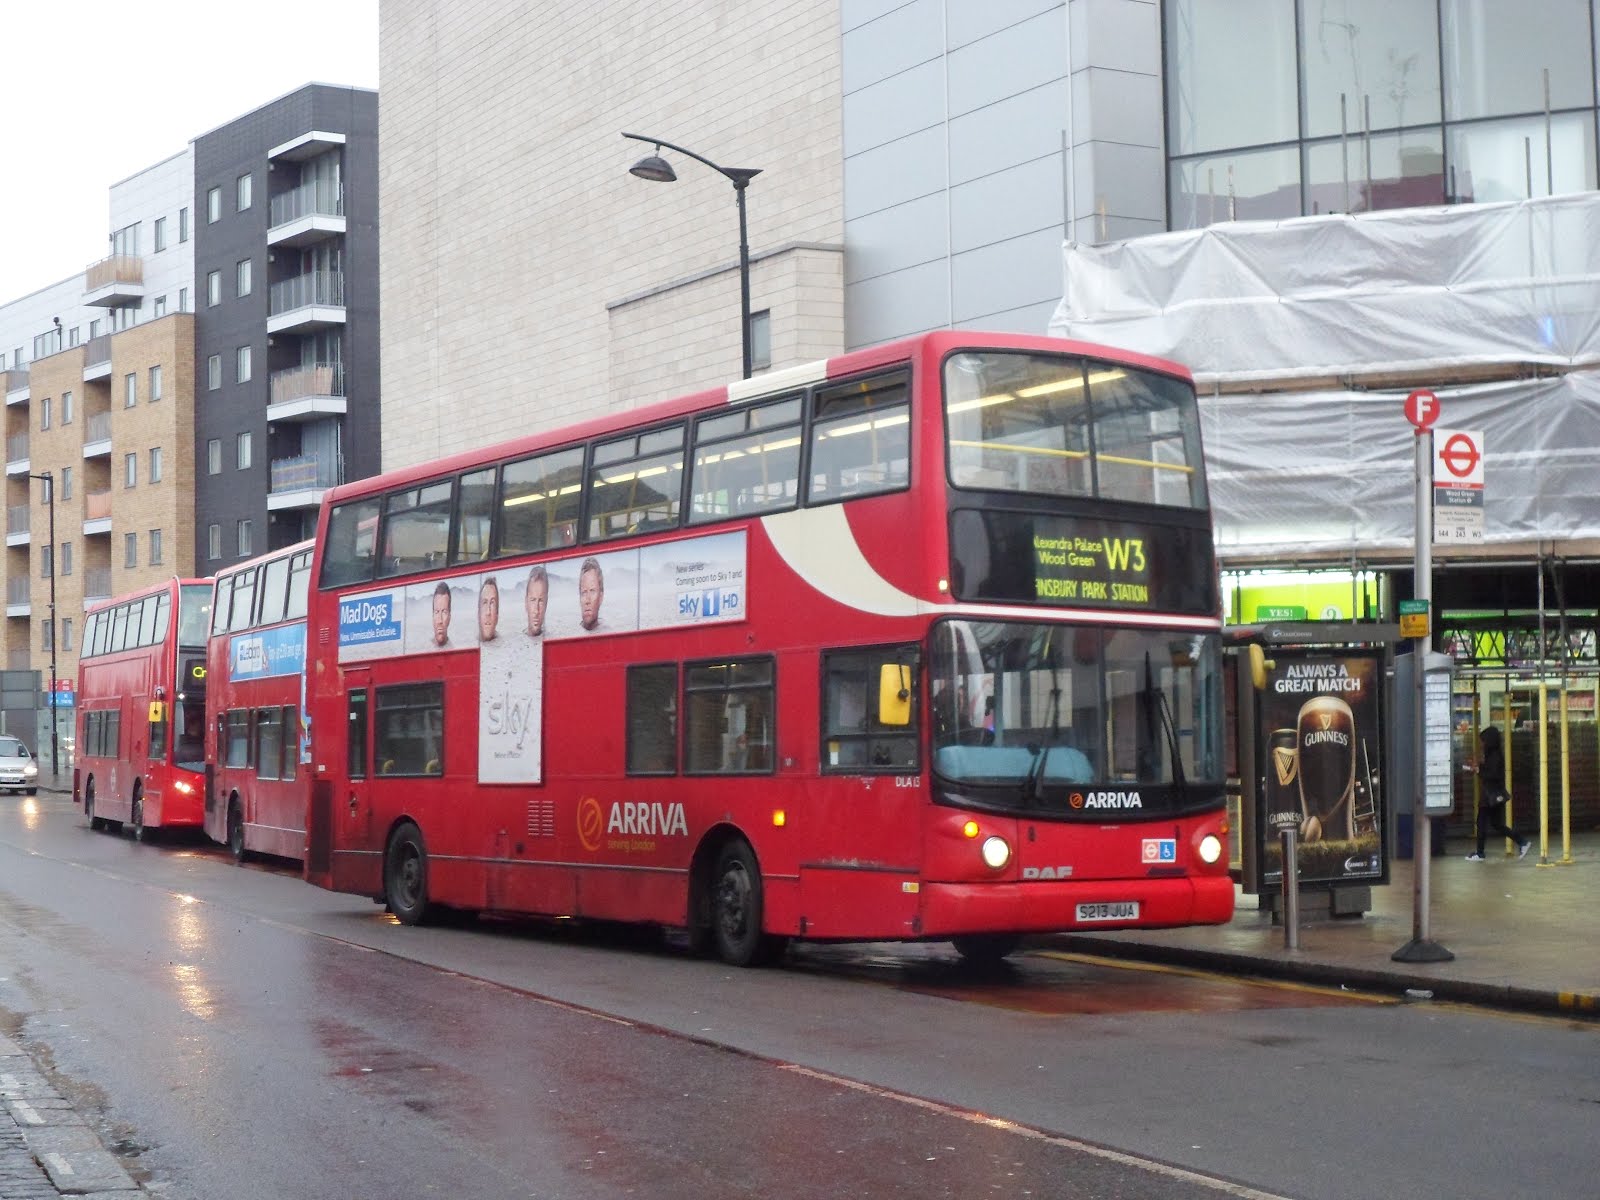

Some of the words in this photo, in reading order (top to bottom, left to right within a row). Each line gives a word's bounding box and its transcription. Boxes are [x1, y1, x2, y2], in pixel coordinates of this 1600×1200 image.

[1416, 395, 1433, 422] F
[1074, 538, 1103, 552] Palace
[1039, 551, 1066, 565] Wood
[1068, 552, 1096, 567] Green
[1103, 537, 1146, 572] W3
[676, 565, 688, 574] New
[688, 563, 704, 572] series
[676, 577, 695, 586] Coming
[696, 576, 709, 584] soon
[710, 574, 717, 582] to
[718, 572, 728, 582] Sky
[732, 569, 742, 579] and
[1081, 581, 1108, 599] PARK
[1111, 583, 1149, 602] STATION
[679, 593, 699, 617] sky
[723, 593, 739, 609] HD
[1269, 608, 1293, 617] YES!
[340, 603, 361, 625] Mad
[362, 602, 388, 626] Dogs
[1287, 664, 1337, 678] ALWAYS
[1339, 664, 1348, 677] A
[1275, 679, 1315, 693] GREAT
[1317, 678, 1361, 692] MATCH
[488, 690, 533, 751] sky
[1305, 730, 1348, 747] GUINNESS
[1084, 791, 1143, 808] ARRIVA
[607, 801, 688, 836] ARRIVA
[1269, 811, 1303, 825] GUINNESS
[631, 838, 656, 851] London
[1023, 865, 1073, 879] DAF
[1080, 904, 1108, 919] S213
[1111, 903, 1135, 918] JUA
